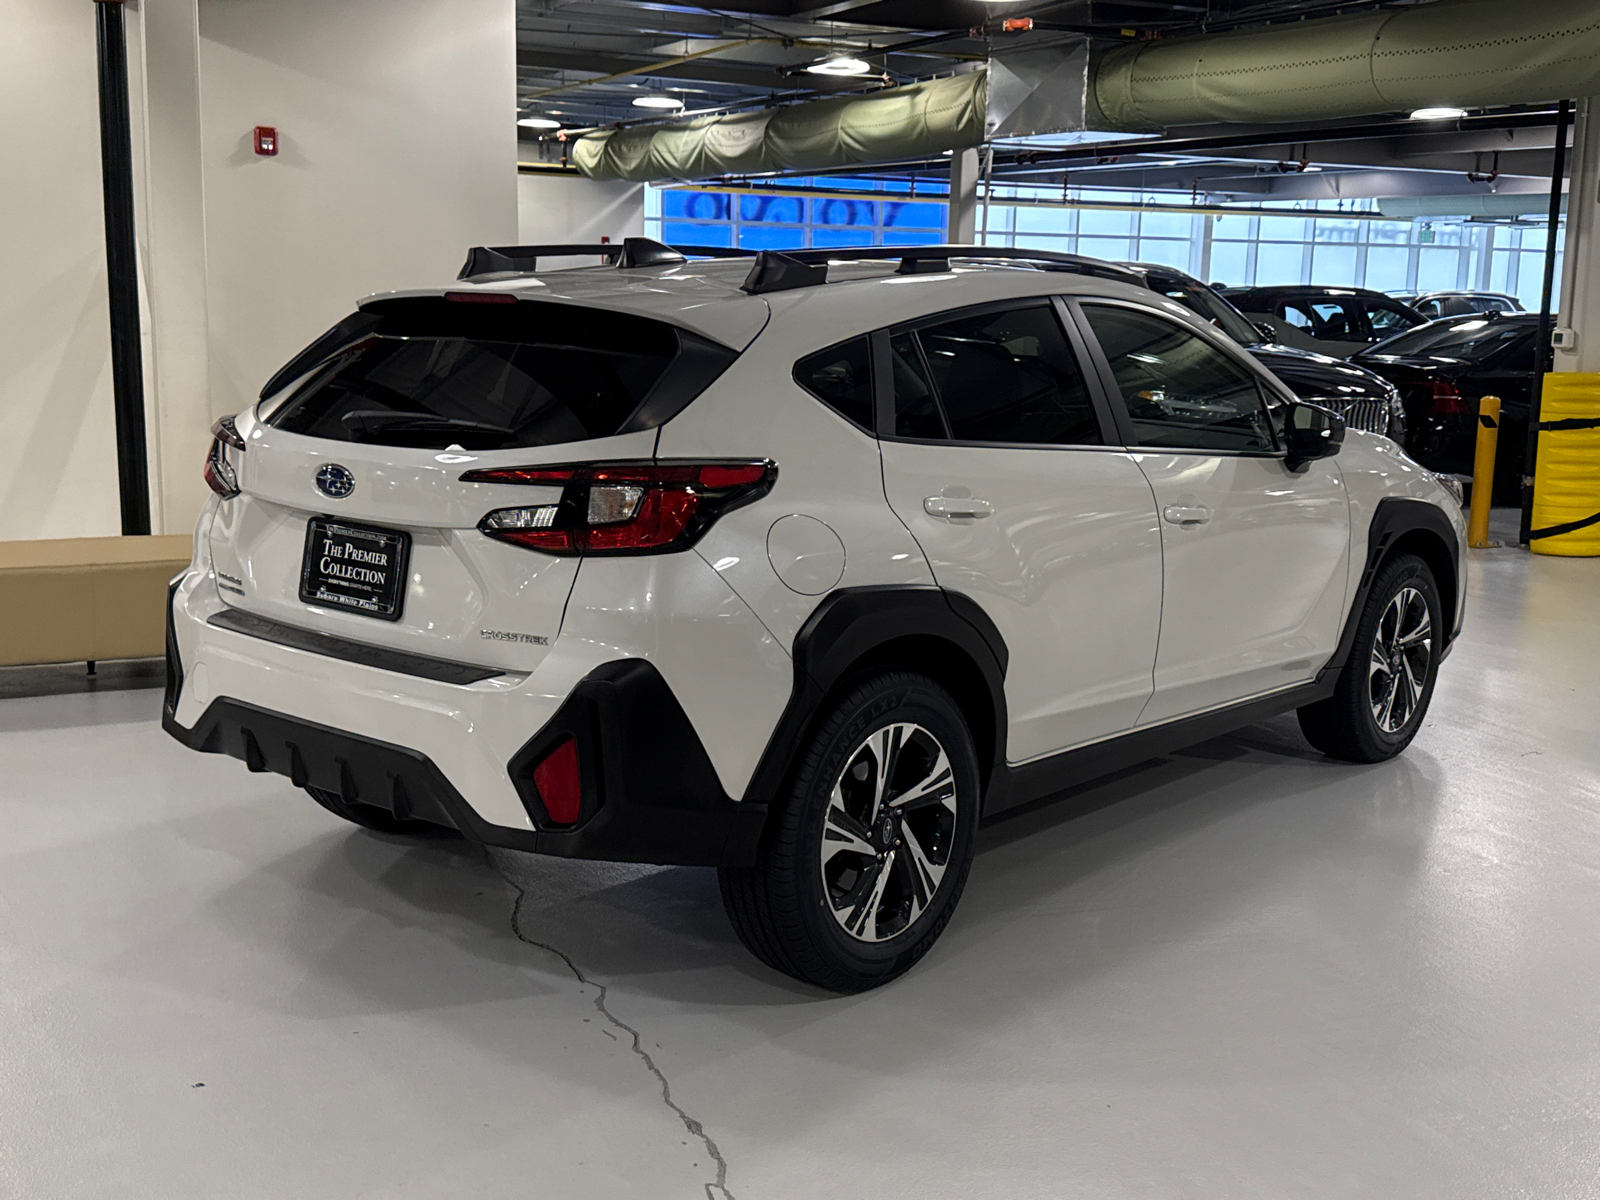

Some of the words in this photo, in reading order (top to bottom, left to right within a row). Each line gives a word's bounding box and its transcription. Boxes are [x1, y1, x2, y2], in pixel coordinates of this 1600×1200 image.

[323, 539, 343, 558] THE
[343, 542, 387, 566] PREMIER
[320, 556, 386, 585] COLLECTION
[339, 596, 358, 606] White
[359, 601, 379, 612] Plains
[480, 629, 549, 646] CROSSTREK
[870, 694, 899, 719] LX2
